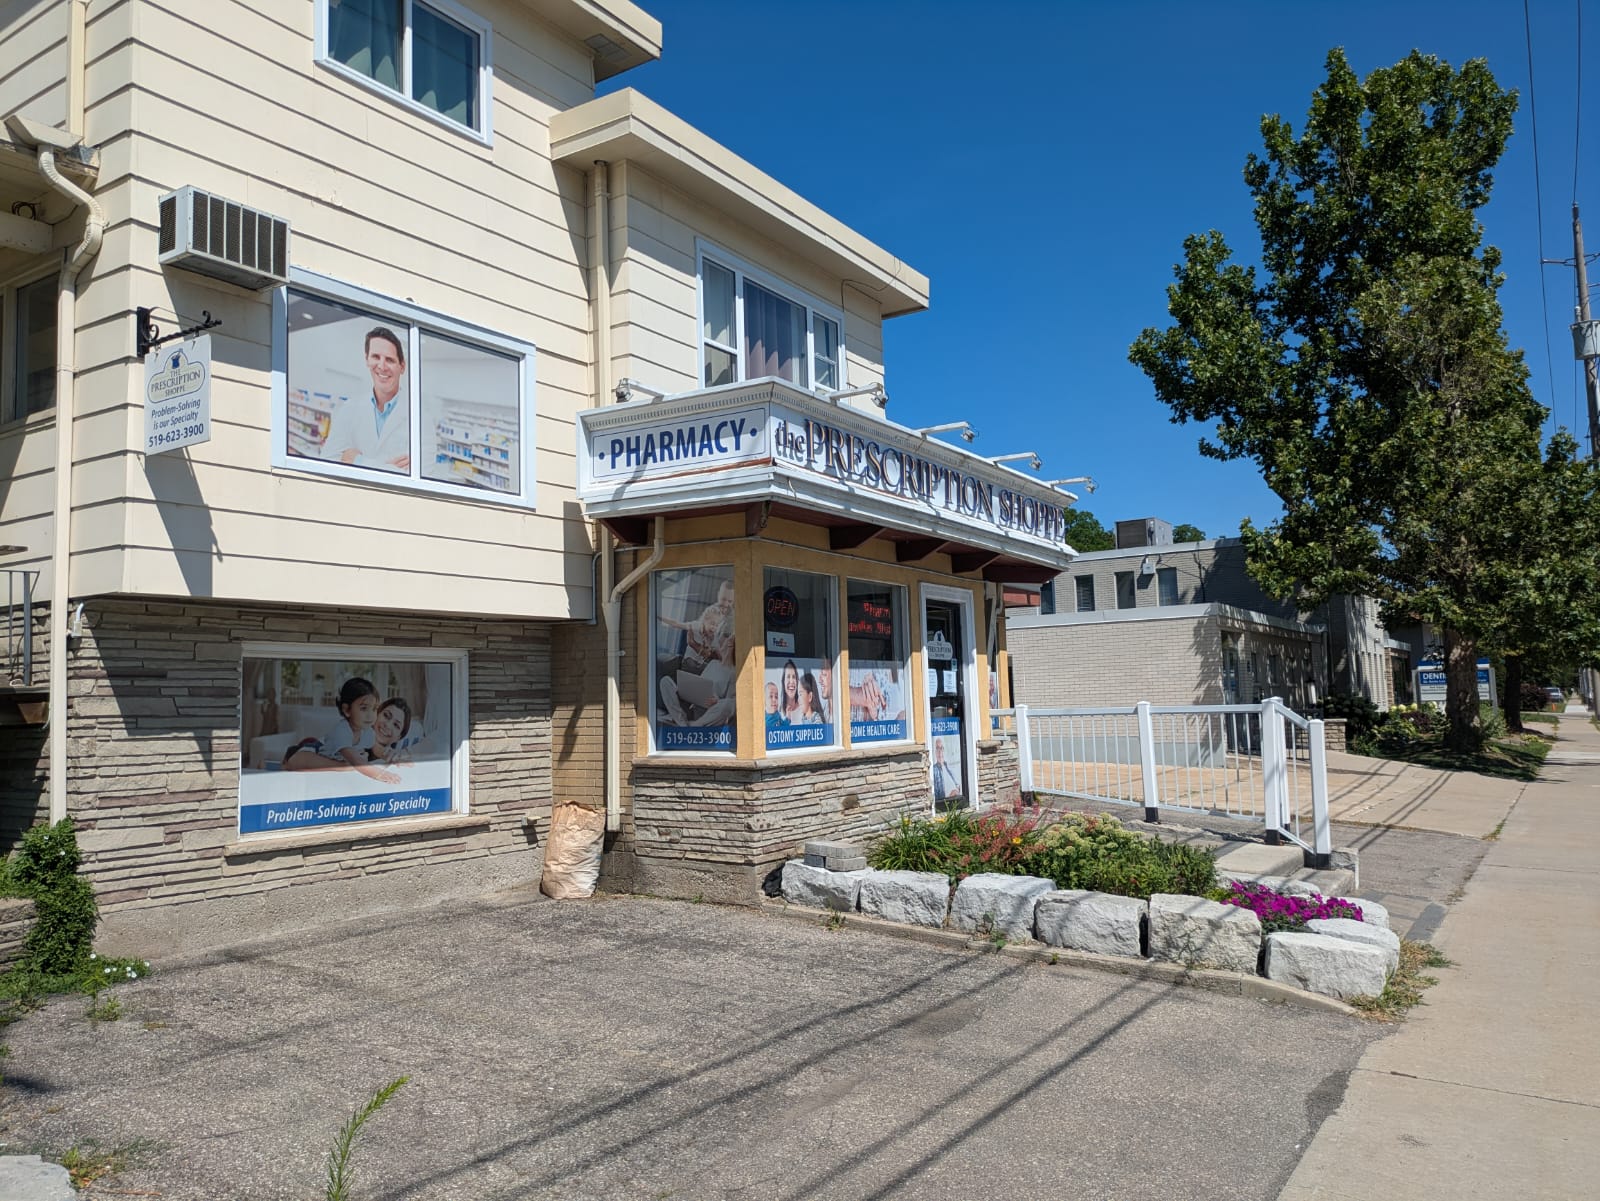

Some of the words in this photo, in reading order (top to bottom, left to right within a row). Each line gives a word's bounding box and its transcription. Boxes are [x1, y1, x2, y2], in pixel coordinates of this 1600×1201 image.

[151, 370, 200, 393] PRESCRIPTION
[151, 399, 200, 418] Problem-Solving
[153, 421, 158, 430] is
[159, 419, 169, 429] our
[170, 411, 199, 427] Specialty
[149, 423, 204, 447] 519-623-3900
[610, 418, 746, 469] PHARMACY
[775, 420, 805, 456] the
[804, 418, 994, 520] PRESCRIPTION
[999, 488, 1066, 541] SHOPPE
[767, 598, 794, 617] OPEN
[1422, 672, 1447, 680] DENTI
[666, 732, 732, 744] 519-623-3900
[768, 730, 794, 744] OSTOMY
[795, 728, 824, 741] SUPPLIES
[866, 724, 887, 736] HEALTH
[887, 723, 900, 735] CARE
[266, 803, 355, 824] Problem-Solving
[358, 803, 366, 814] is
[369, 802, 386, 813] our
[388, 795, 431, 813] Specialty
